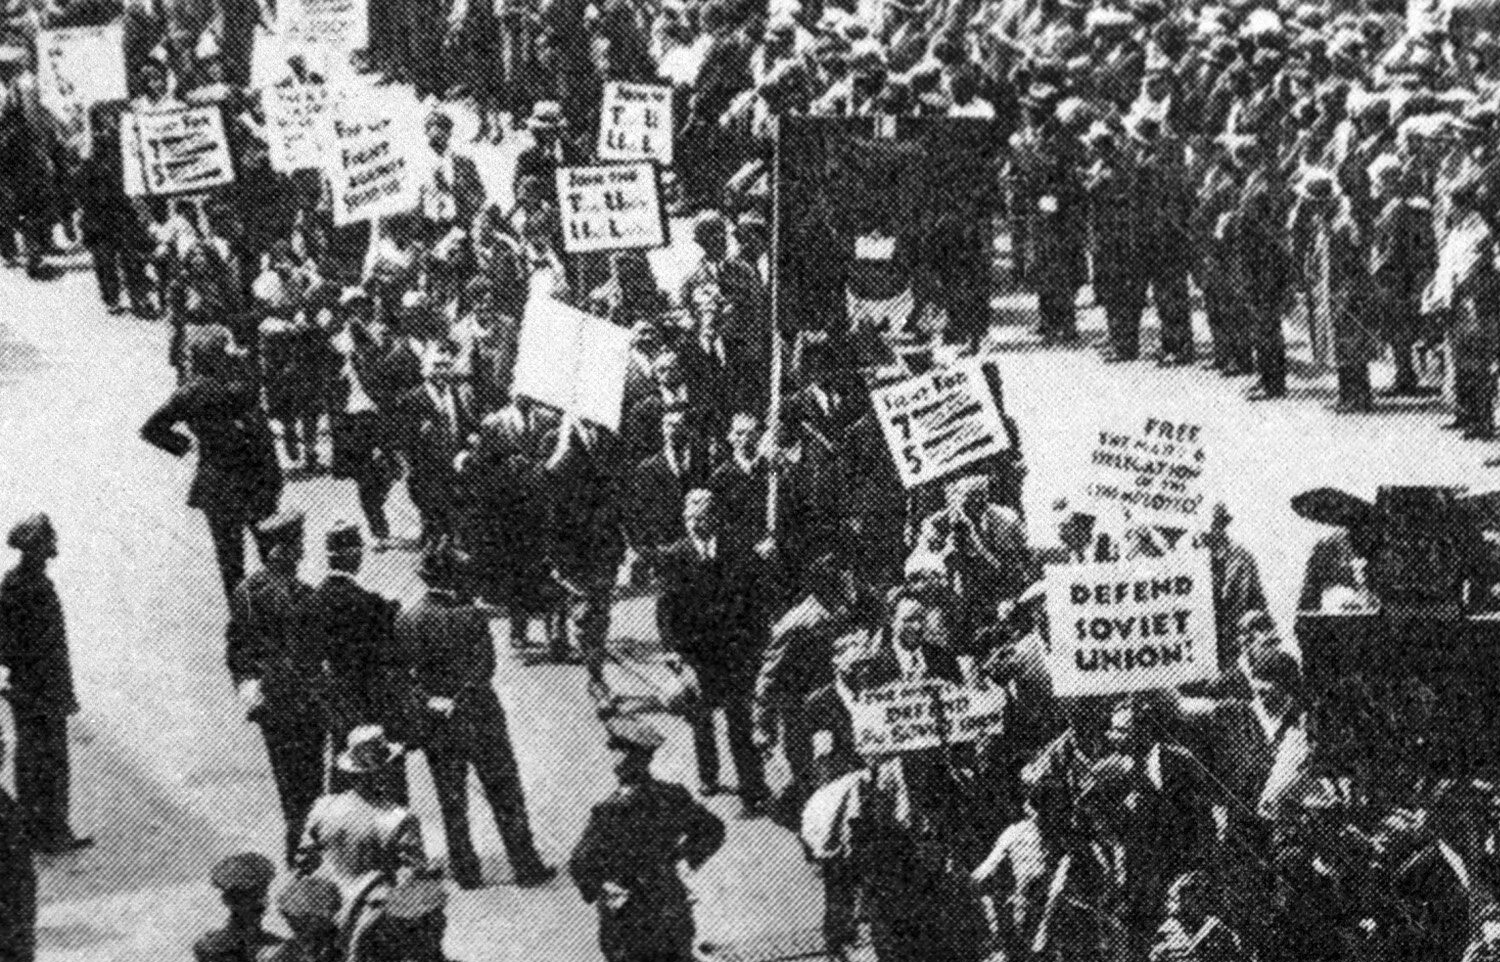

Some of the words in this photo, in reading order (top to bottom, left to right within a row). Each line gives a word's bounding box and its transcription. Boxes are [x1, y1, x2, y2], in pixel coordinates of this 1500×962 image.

[890, 413, 911, 439] 7
[1144, 417, 1201, 443] FREE
[902, 445, 922, 474] 5
[1070, 575, 1195, 605] DEFEND
[1074, 609, 1192, 641] SOVIET
[1074, 640, 1194, 672] UNION!
